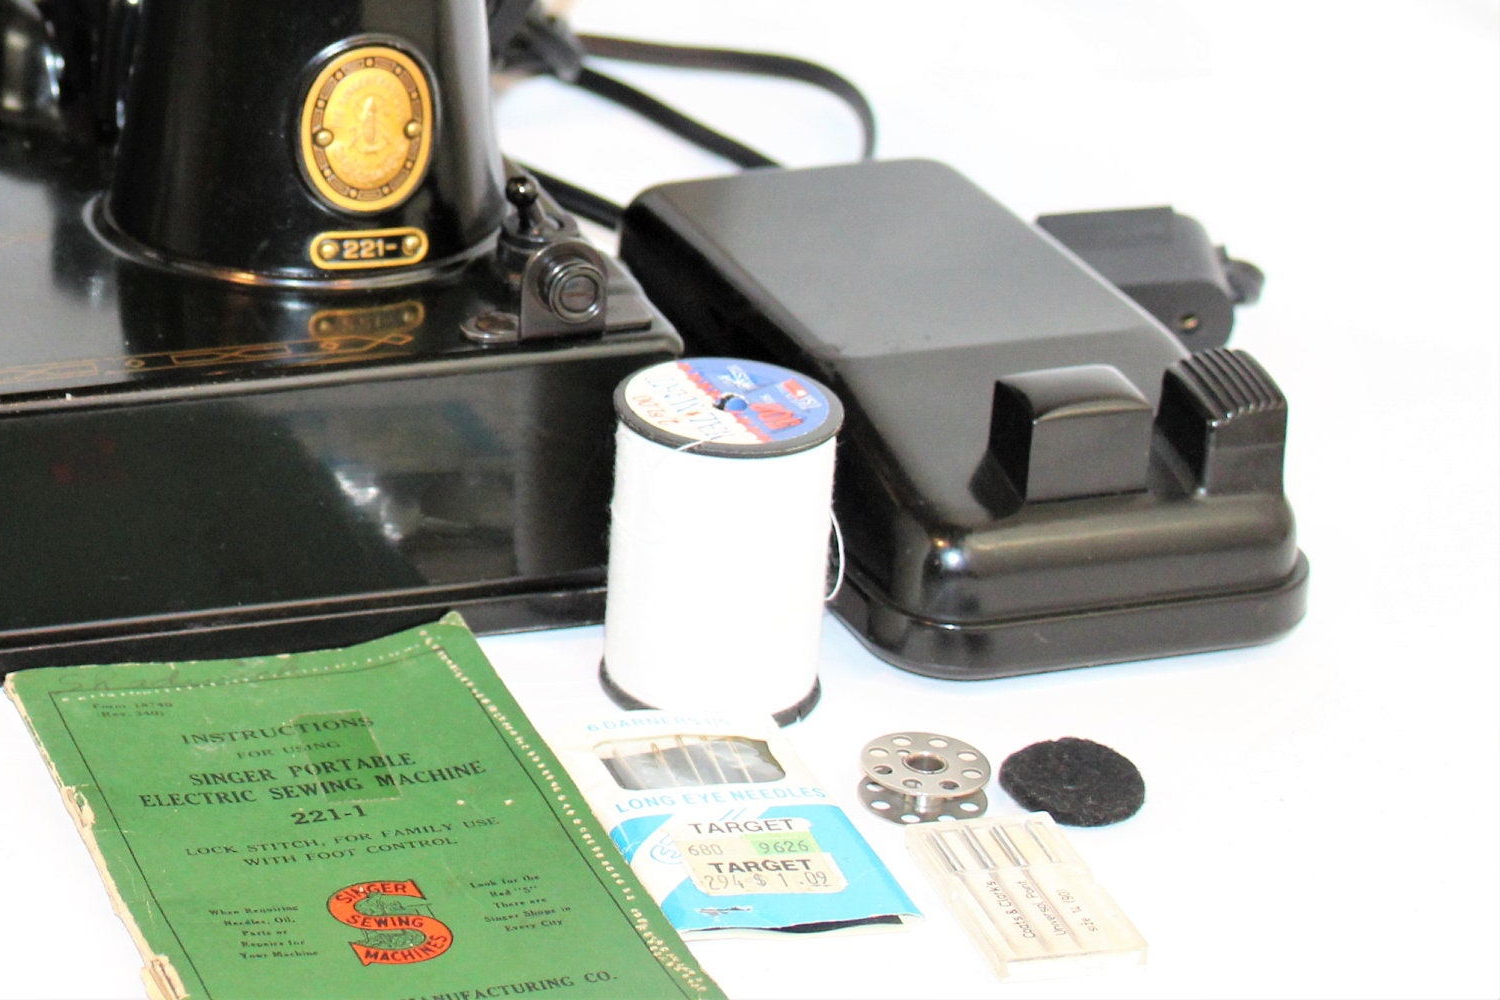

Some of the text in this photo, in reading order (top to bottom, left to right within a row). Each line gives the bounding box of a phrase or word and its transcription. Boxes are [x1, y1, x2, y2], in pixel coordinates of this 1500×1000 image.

[343, 239, 397, 259] 221-
[181, 716, 374, 745] INSTRUCTIONS
[236, 741, 341, 760] FOR USING
[189, 753, 416, 786] SINGER PORTABLE
[139, 760, 487, 808] ELECTRIC SEWING MACHINE
[615, 786, 827, 813] LONG EYE NEEDLES
[291, 804, 367, 825] 221-1
[186, 816, 500, 856] LOCK STITCH, FOR FAMILY USE
[688, 818, 793, 834] TARGET
[243, 837, 458, 867] WITH FOOT CONTROL
[758, 839, 809, 854] 9626
[707, 858, 811, 874] TARGET
[703, 875, 745, 890] 294
[336, 883, 407, 904] SINGER
[346, 915, 424, 928] SEWING
[540, 919, 562, 927] City
[365, 935, 448, 961] MACHINES
[399, 970, 618, 1000] NUFACTURING CO.
